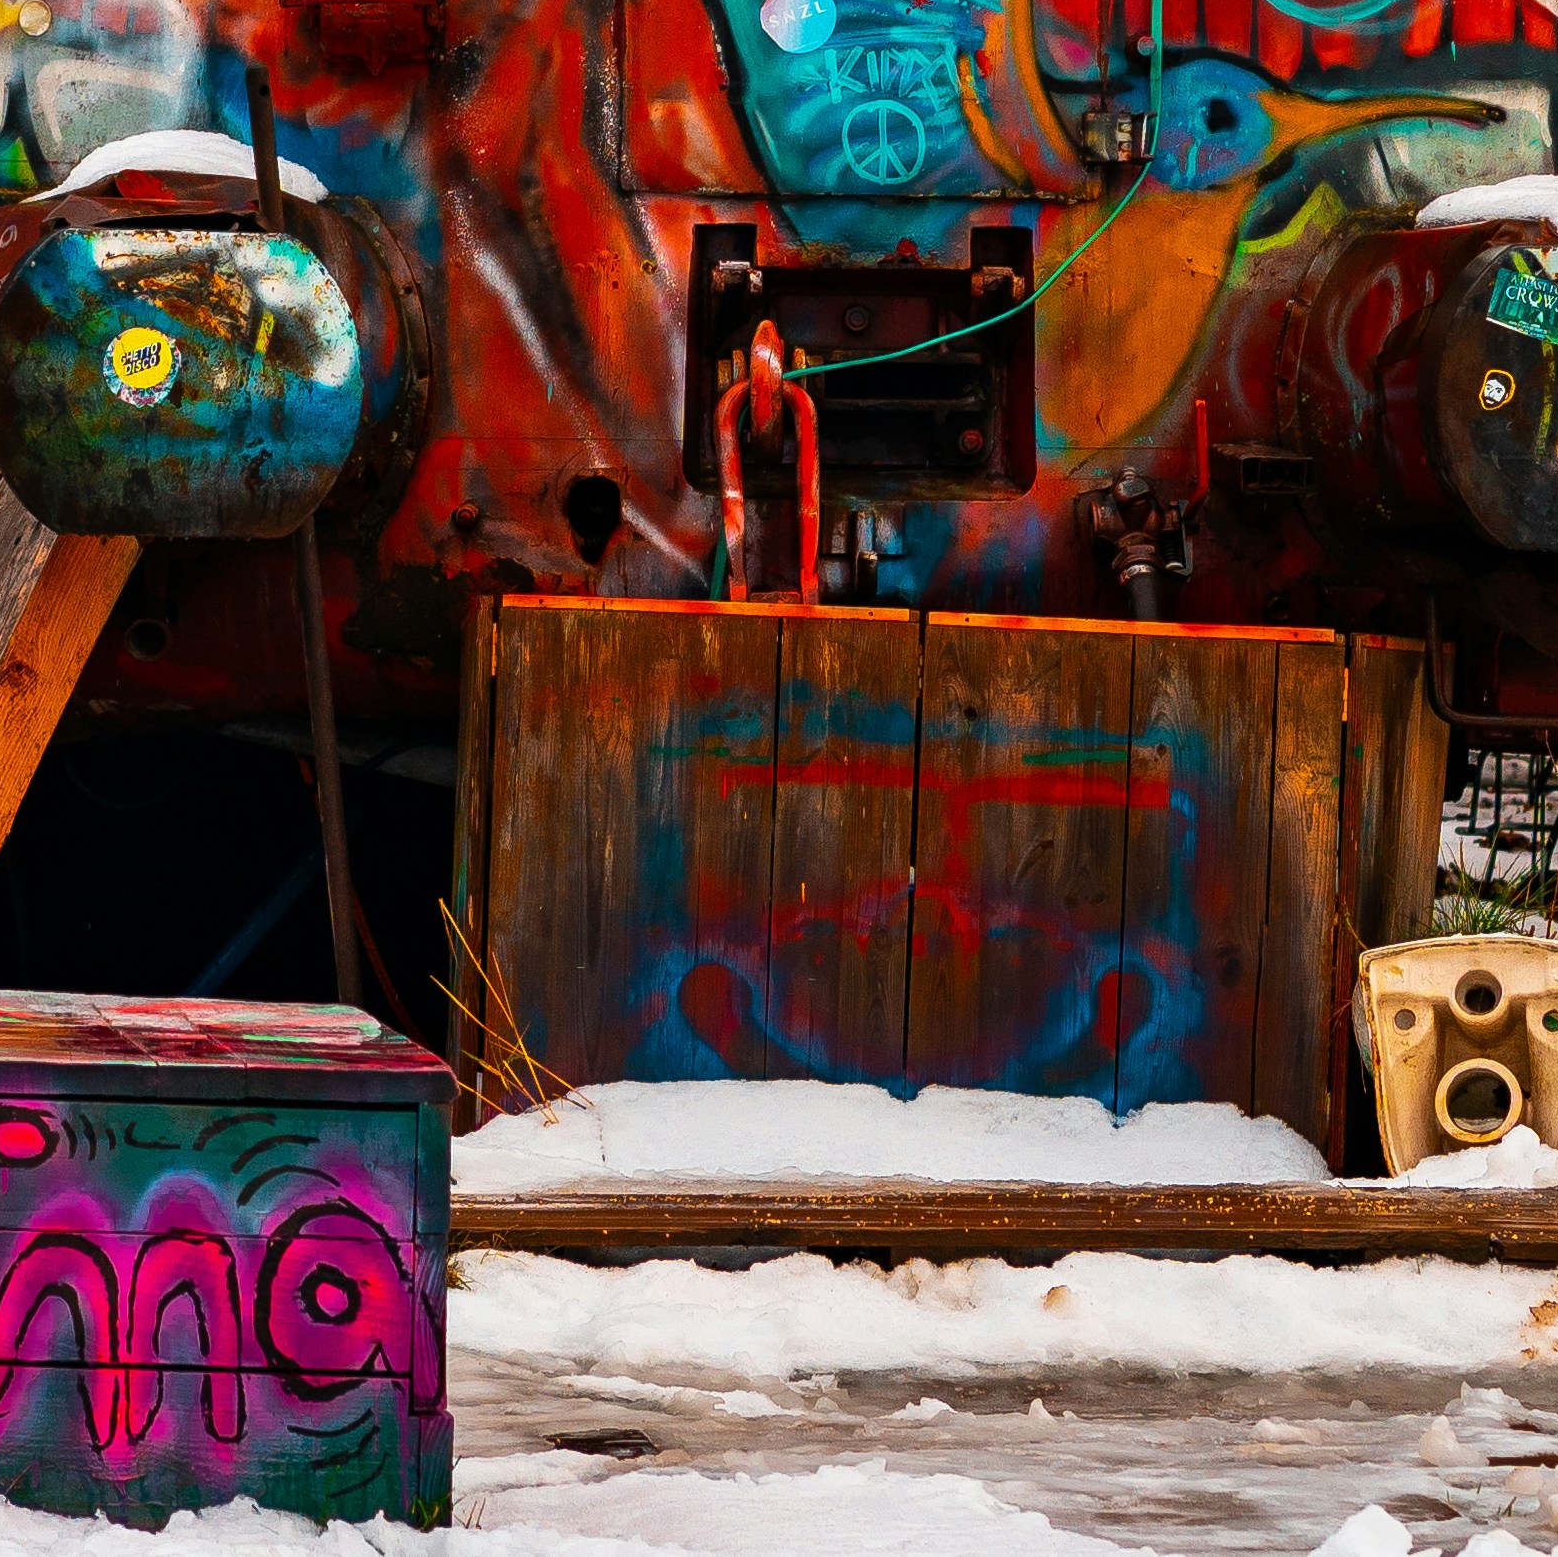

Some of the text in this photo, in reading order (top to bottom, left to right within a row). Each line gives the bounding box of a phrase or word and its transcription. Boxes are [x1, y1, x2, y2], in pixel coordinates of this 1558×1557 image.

[768, 0, 827, 29] SNZL
[121, 342, 161, 365] GHETTO
[125, 355, 160, 376] DISCO
